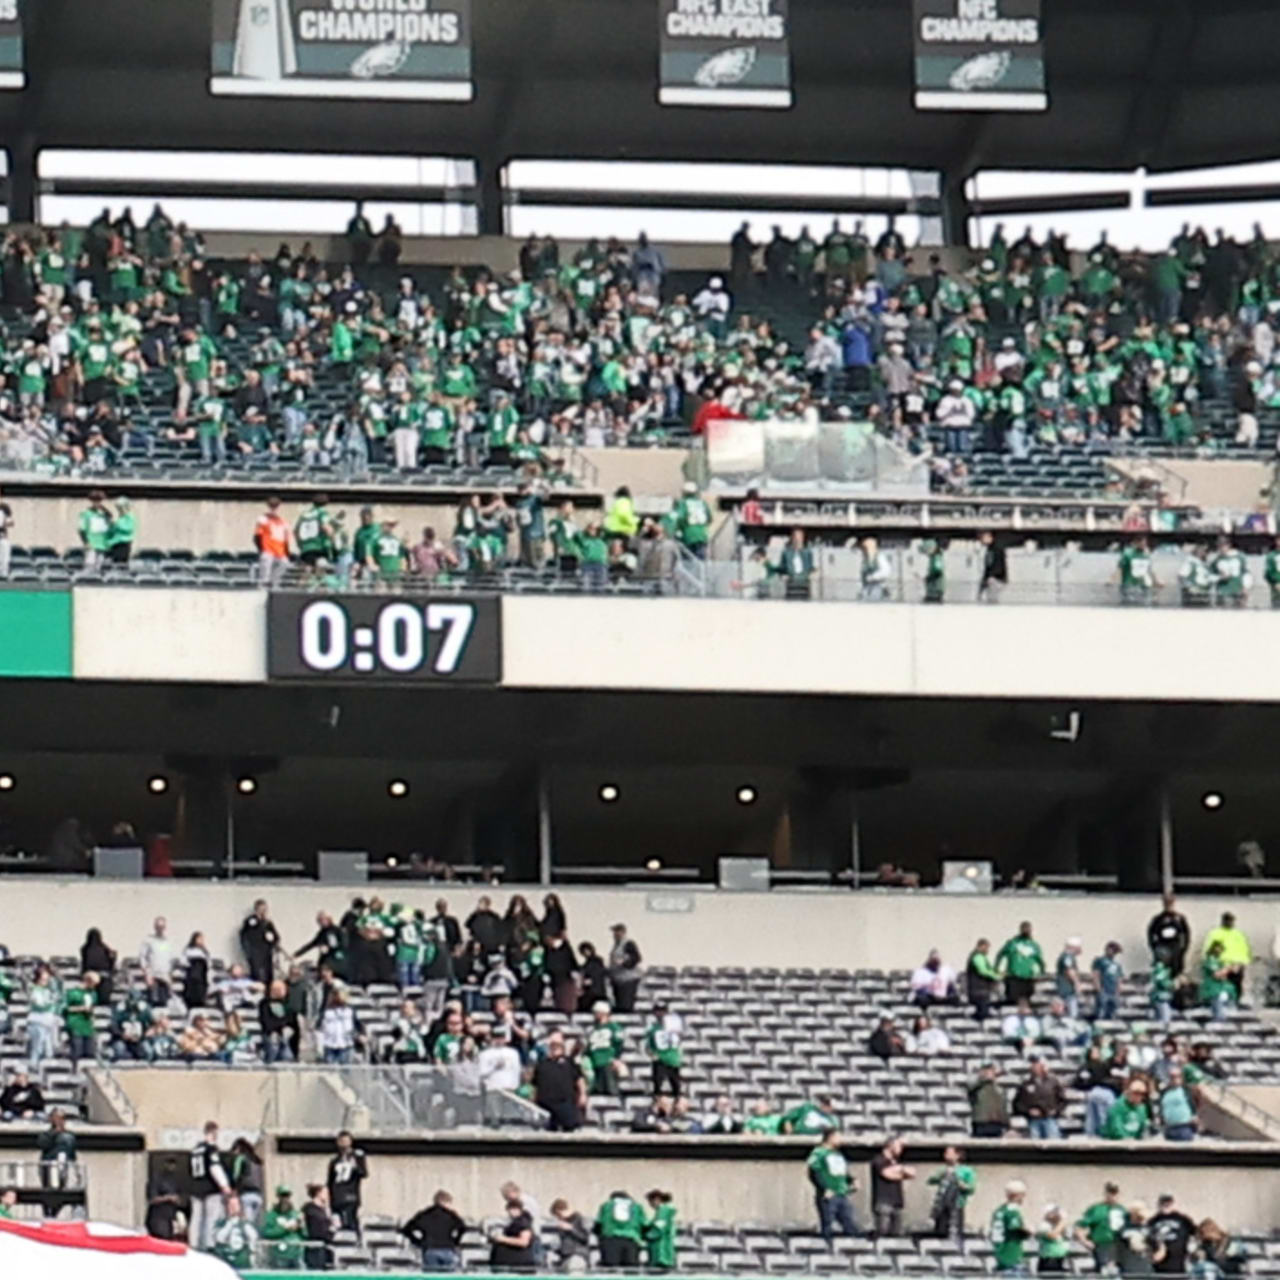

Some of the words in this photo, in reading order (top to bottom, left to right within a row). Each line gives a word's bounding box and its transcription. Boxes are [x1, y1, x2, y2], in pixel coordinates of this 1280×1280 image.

[299, 10, 458, 41] CHAMPIONS
[667, 13, 784, 38] CHAMPIONS
[921, 17, 1038, 41] CHAMPIONS
[302, 601, 472, 672] 0:07
